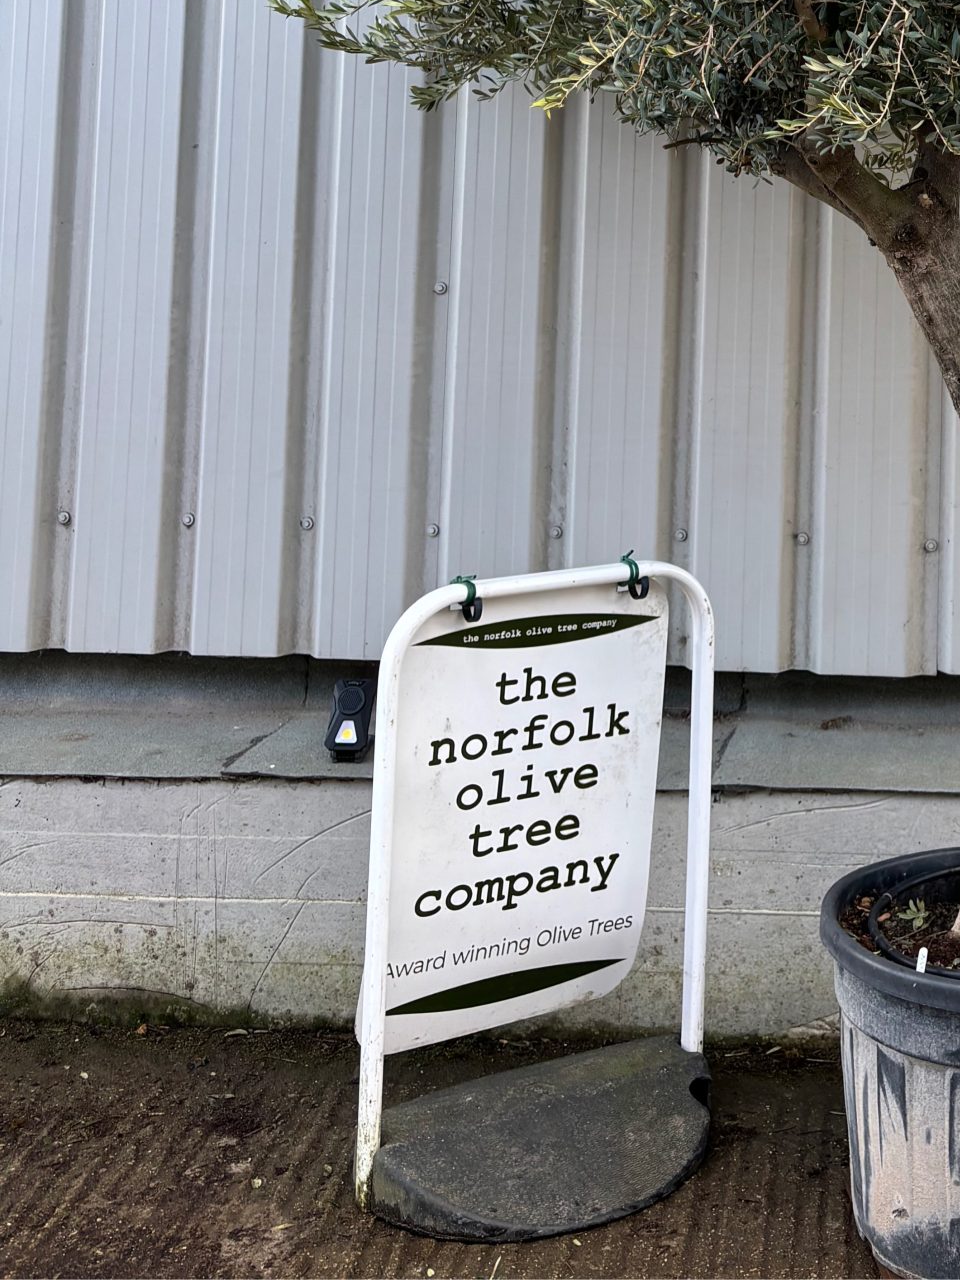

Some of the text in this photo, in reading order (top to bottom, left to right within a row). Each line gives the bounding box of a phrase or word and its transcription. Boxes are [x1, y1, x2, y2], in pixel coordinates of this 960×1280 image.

[463, 618, 618, 643] the norfolk olive tree company
[496, 667, 577, 706] the
[428, 703, 631, 767] norfolk
[456, 762, 599, 811] olive
[468, 814, 580, 858] tree
[414, 852, 620, 918] company
[452, 935, 531, 966] winning
[536, 926, 582, 948] Olive
[588, 915, 633, 937] Trees
